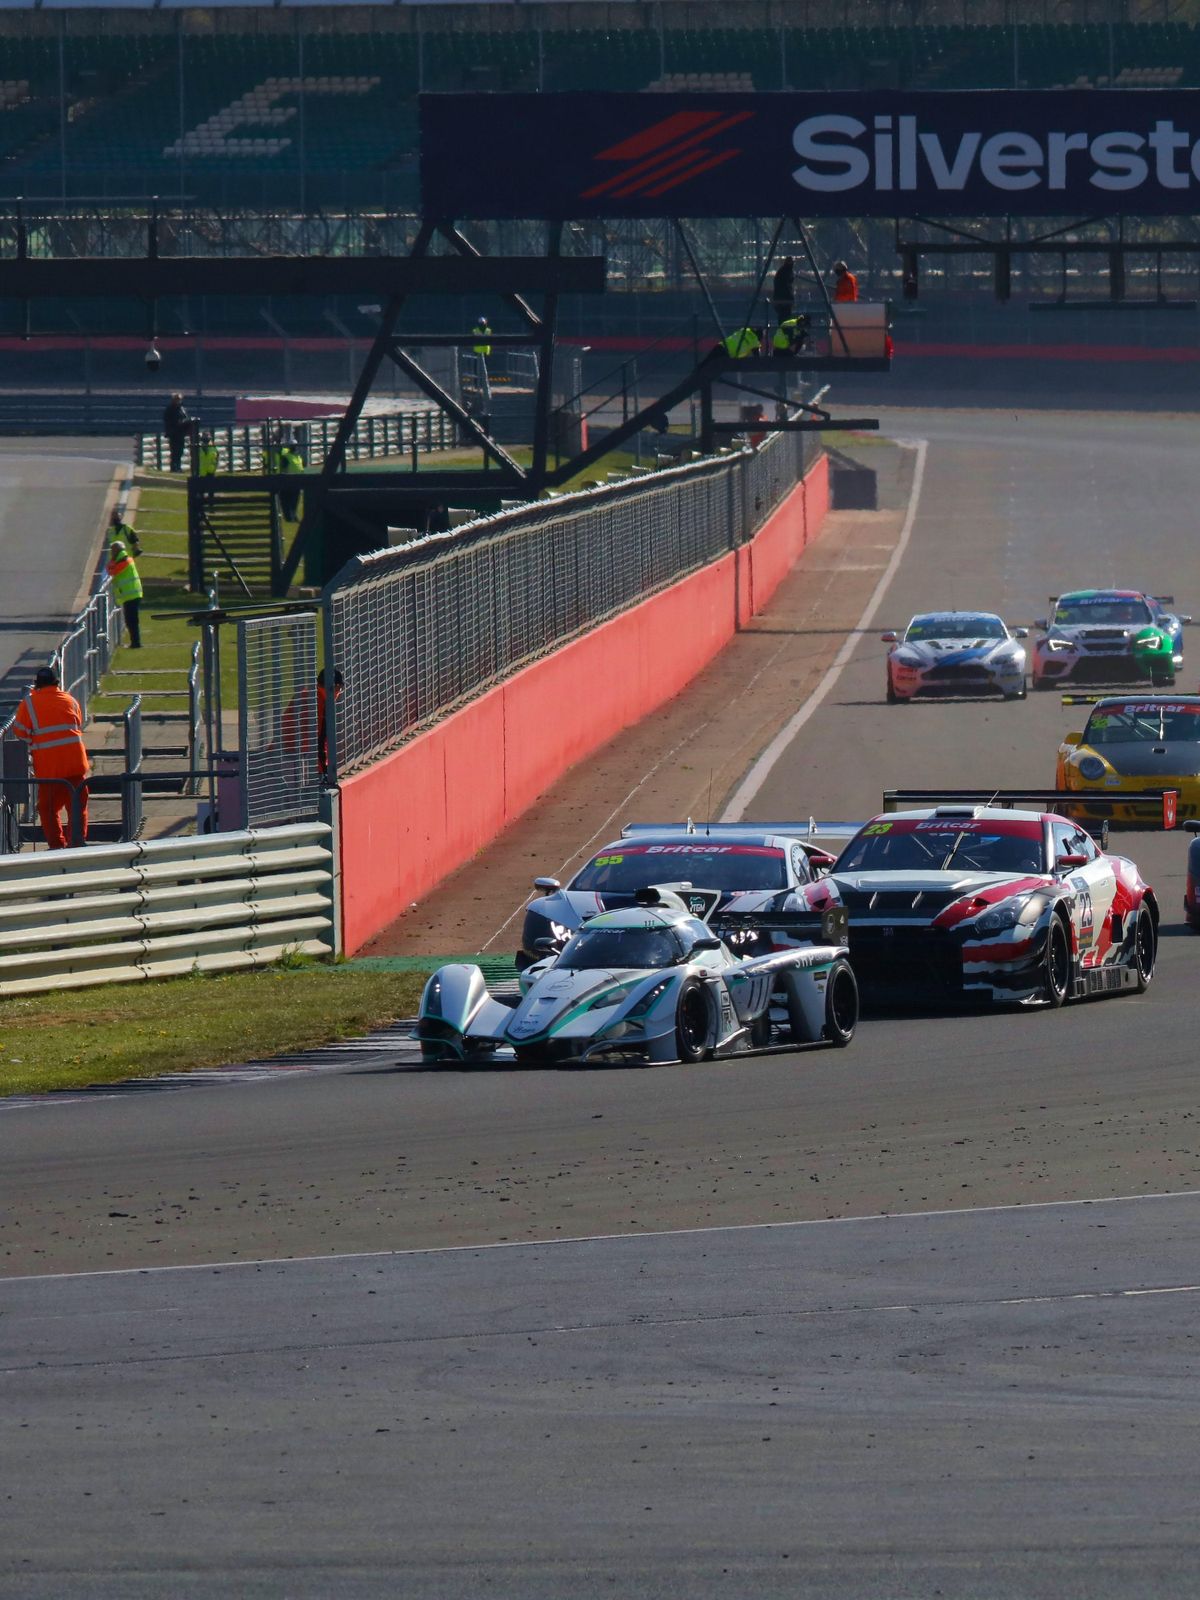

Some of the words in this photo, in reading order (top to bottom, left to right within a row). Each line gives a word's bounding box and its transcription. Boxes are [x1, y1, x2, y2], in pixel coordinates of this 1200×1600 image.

[1124, 704, 1186, 714] Britcar
[863, 823, 894, 836] 23
[915, 822, 982, 830] Britcar
[646, 845, 733, 854] Britcar
[595, 855, 624, 867] 55
